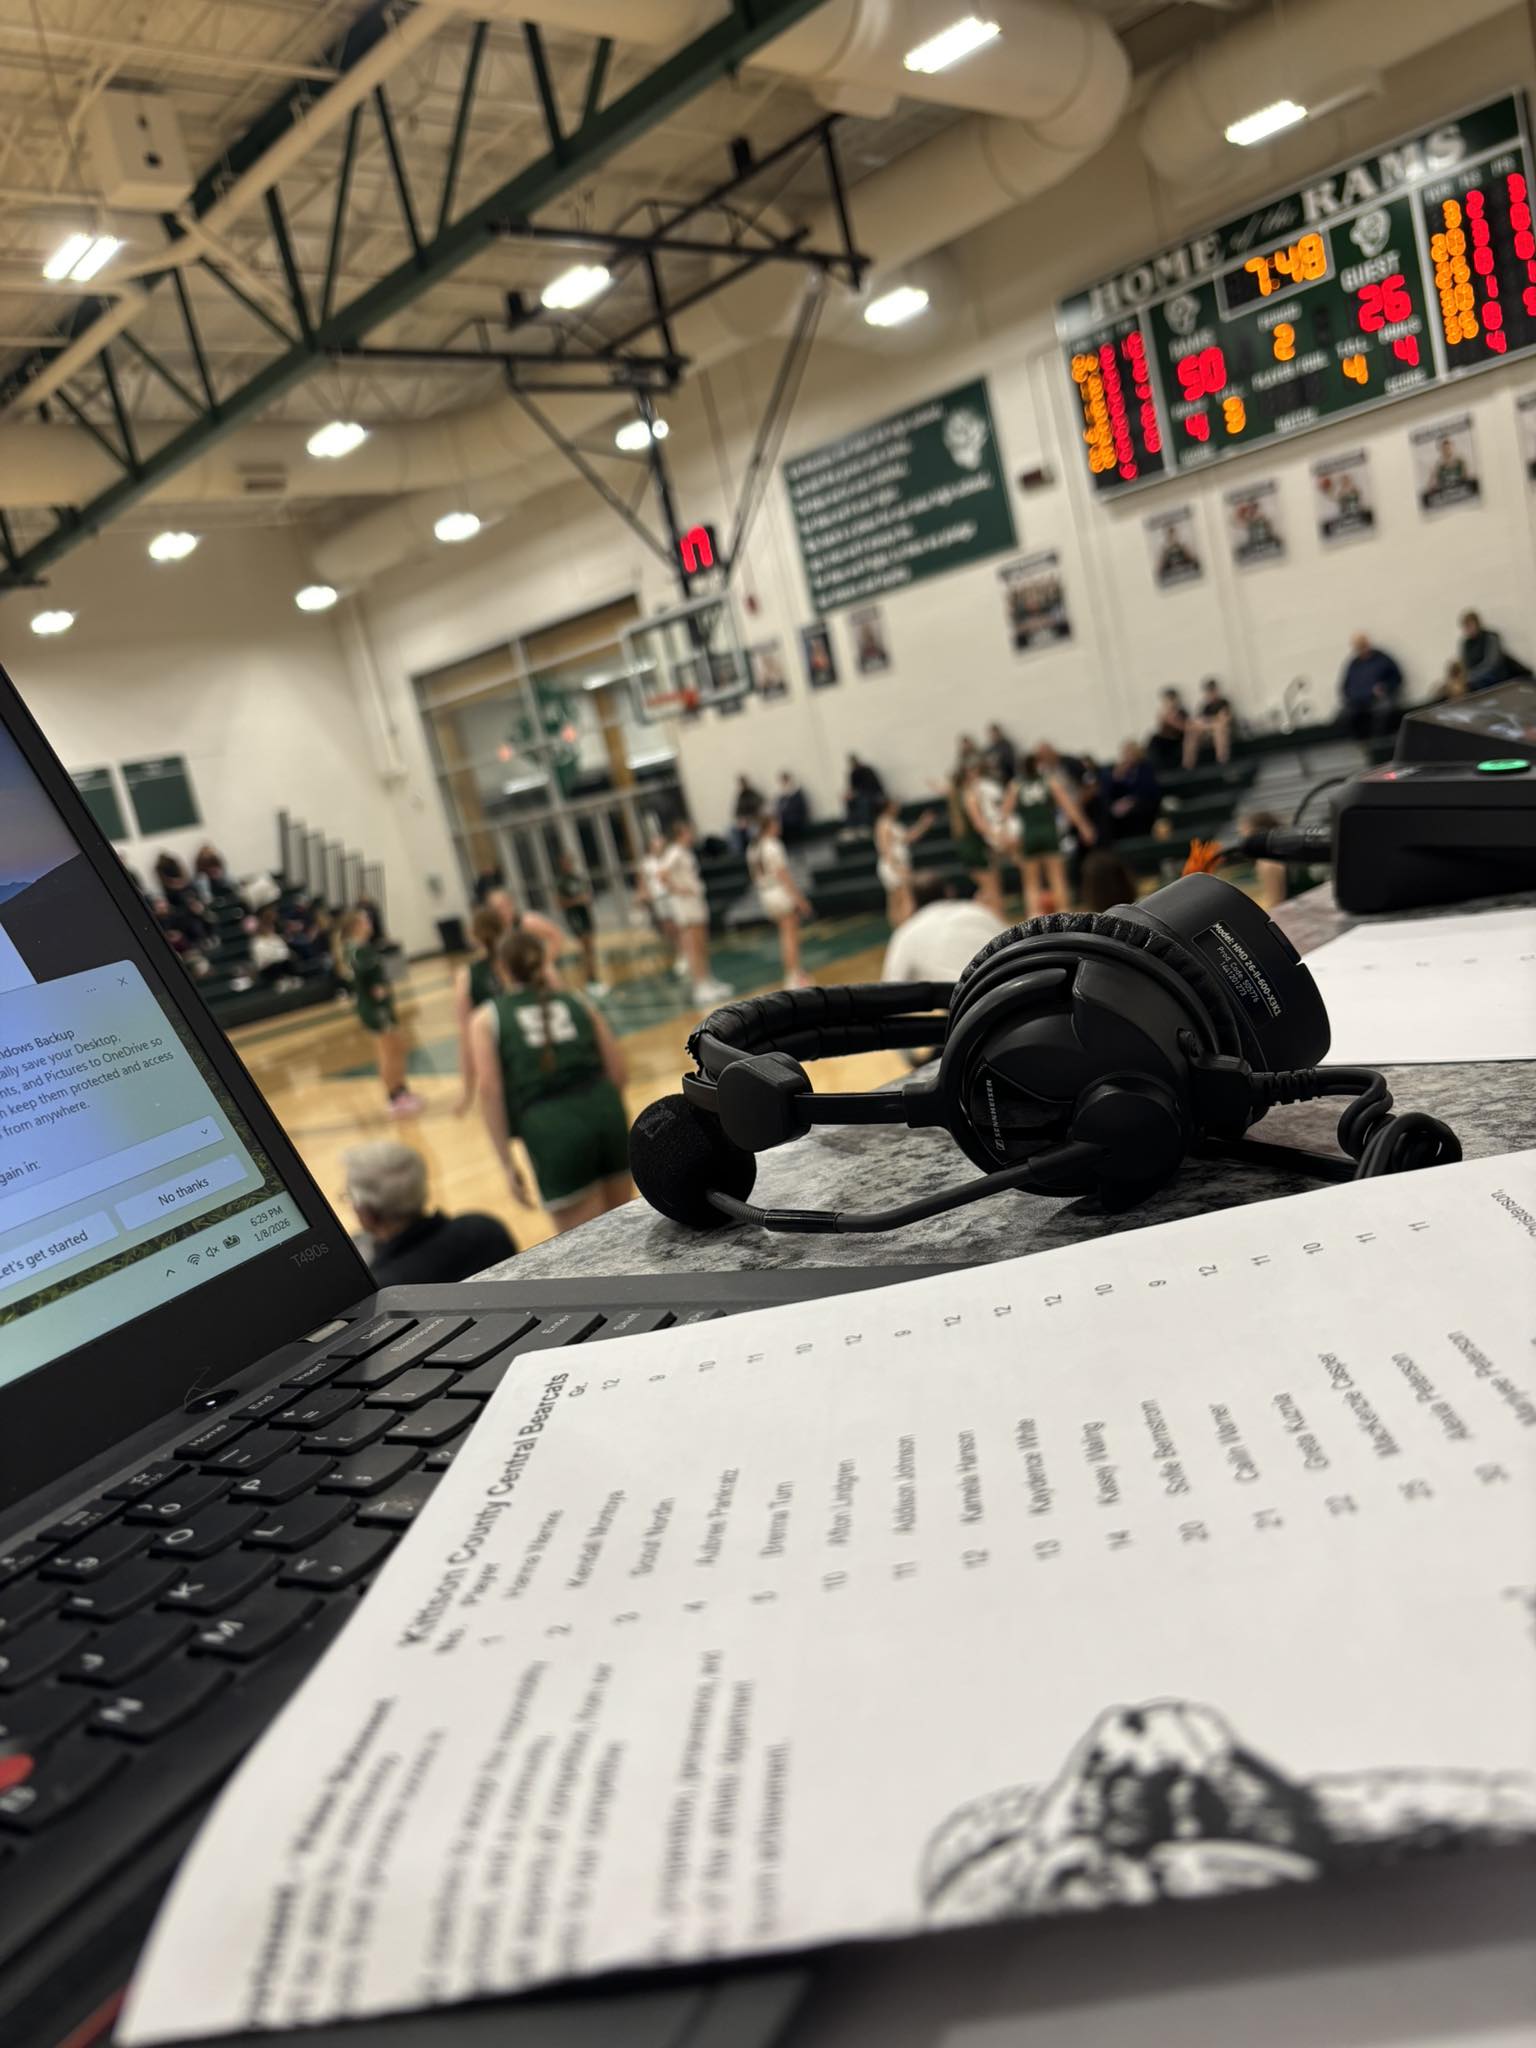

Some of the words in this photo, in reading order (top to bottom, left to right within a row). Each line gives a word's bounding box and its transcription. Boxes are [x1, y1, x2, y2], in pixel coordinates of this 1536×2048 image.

[1090, 236, 1222, 318] HOME
[1302, 125, 1467, 224] RAMS
[1357, 274, 1412, 332] 26
[1177, 346, 1227, 402] 50
[1212, 923, 1234, 944] Model:
[1232, 943, 1248, 961] HMD
[34, 1029, 75, 1048] Backup
[22, 1057, 47, 1072] save
[48, 1048, 73, 1065] your
[74, 1033, 121, 1054] Desktop,
[23, 1075, 44, 1091] and
[45, 1062, 89, 1083] Pictures
[89, 1058, 101, 1068] to
[102, 1042, 149, 1063] OneDrive
[150, 1037, 163, 1048] so
[7, 1097, 38, 1115] keep
[38, 1089, 69, 1104] them
[69, 1070, 121, 1096] protected
[122, 1060, 142, 1075] and
[143, 1051, 175, 1069] access
[986, 1080, 1001, 1137] SENNHEISER
[3, 1120, 34, 1136] from
[34, 1100, 90, 1125] anywhere.
[23, 1160, 41, 1173] in:
[158, 1190, 177, 1207] No
[176, 1177, 210, 1202] thanks
[250, 1212, 268, 1226] 6:29
[268, 1205, 283, 1218] PM
[254, 1218, 291, 1242] 1/8/2026
[1408, 1221, 1431, 1233] 11
[1355, 1232, 1377, 1244] 11
[0, 1261, 24, 1280] et's
[25, 1249, 47, 1269] get
[47, 1229, 88, 1256] started
[290, 1243, 329, 1268] T490s
[1303, 1241, 1324, 1256] 10
[1250, 1255, 1271, 1267] 11
[1198, 1264, 1218, 1278] 12
[1094, 1283, 1114, 1297] 10
[1148, 1279, 1167, 1288] 9
[1044, 1293, 1063, 1308] 12
[993, 1304, 1012, 1318] 12
[943, 1314, 961, 1327] 12
[845, 1333, 863, 1346] 12
[795, 1343, 813, 1355] 10
[747, 1352, 765, 1364] 11
[698, 1360, 716, 1373] 10
[602, 1378, 620, 1391] 12
[447, 1500, 511, 1565] County
[487, 1437, 538, 1498] Central
[518, 1373, 569, 1436] Bearcats
[241, 1479, 261, 1491] P
